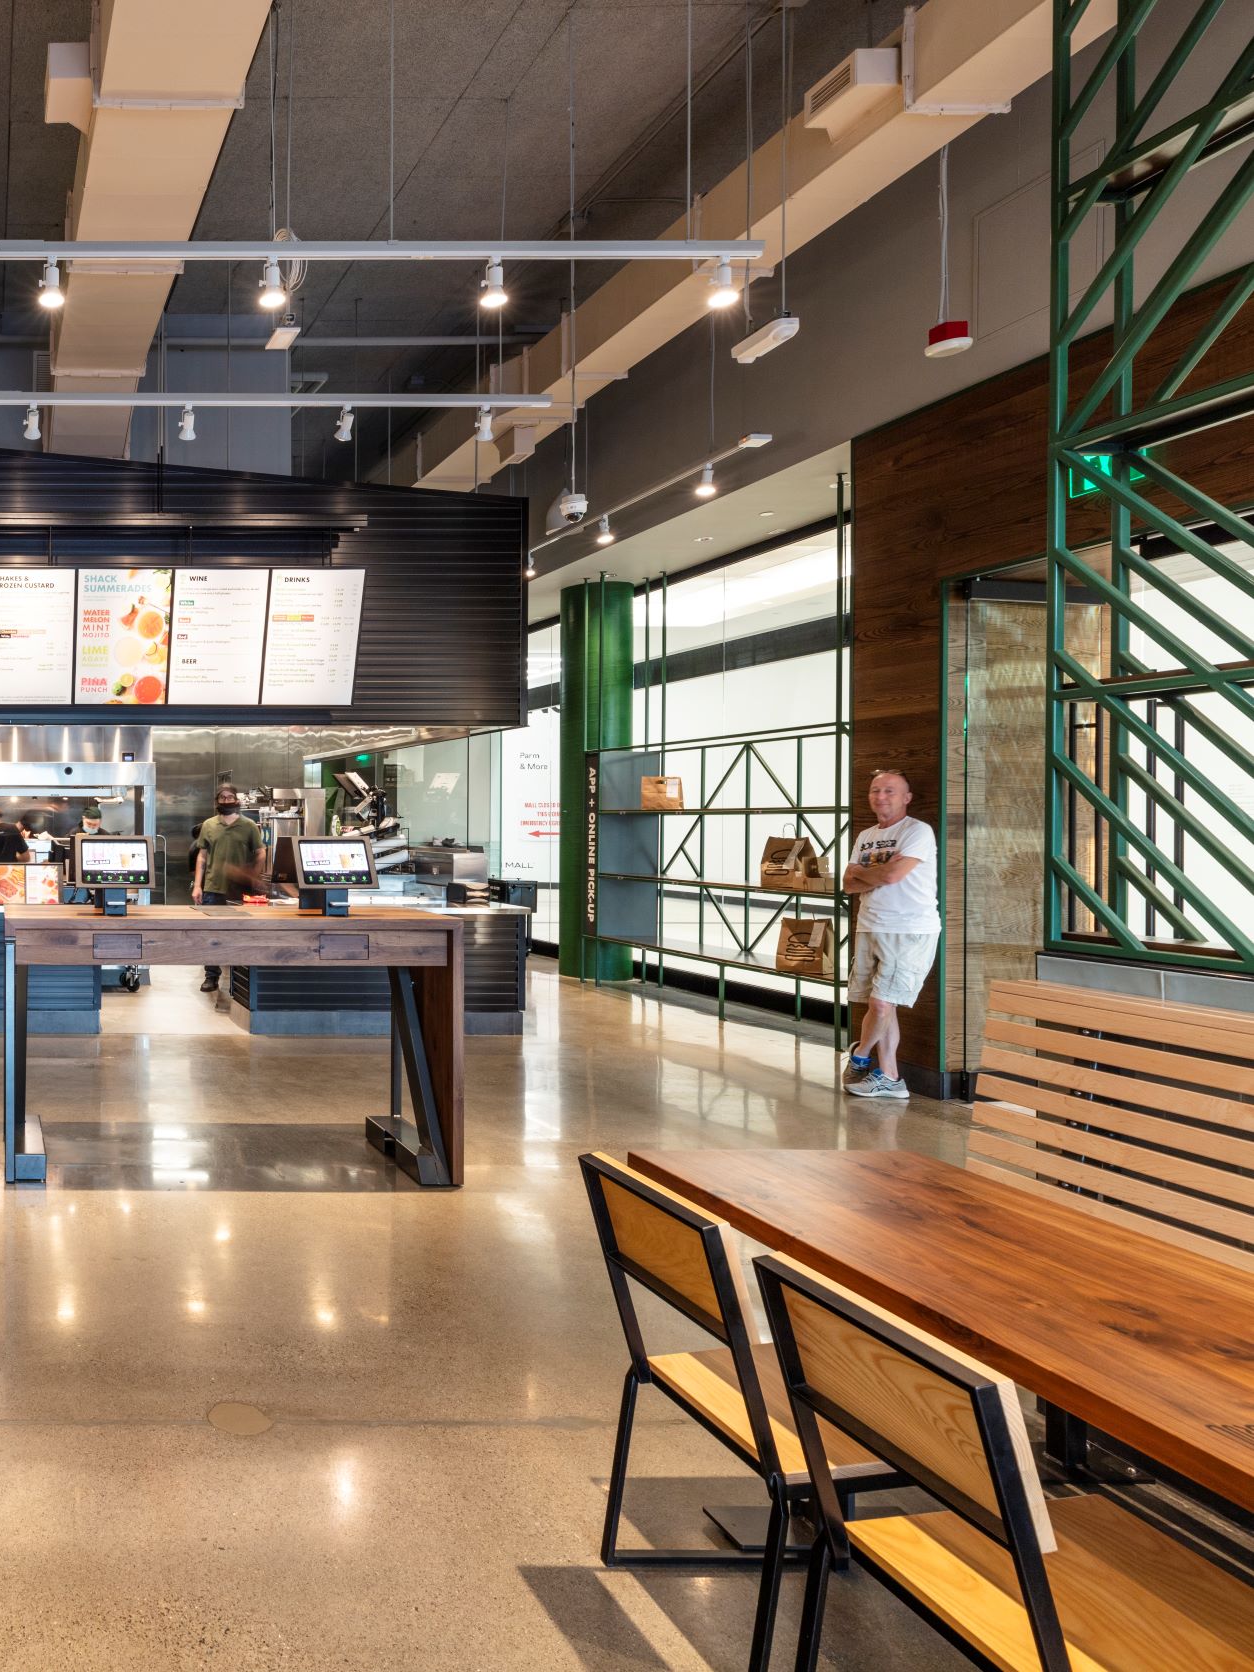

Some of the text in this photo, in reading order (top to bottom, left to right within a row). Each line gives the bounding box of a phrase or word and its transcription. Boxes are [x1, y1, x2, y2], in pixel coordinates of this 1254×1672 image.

[83, 575, 118, 583] SHACK
[83, 584, 153, 593] SUMMERADES
[81, 646, 109, 655] LIME
[587, 766, 596, 923] APP + ONLINE PICK-UP
